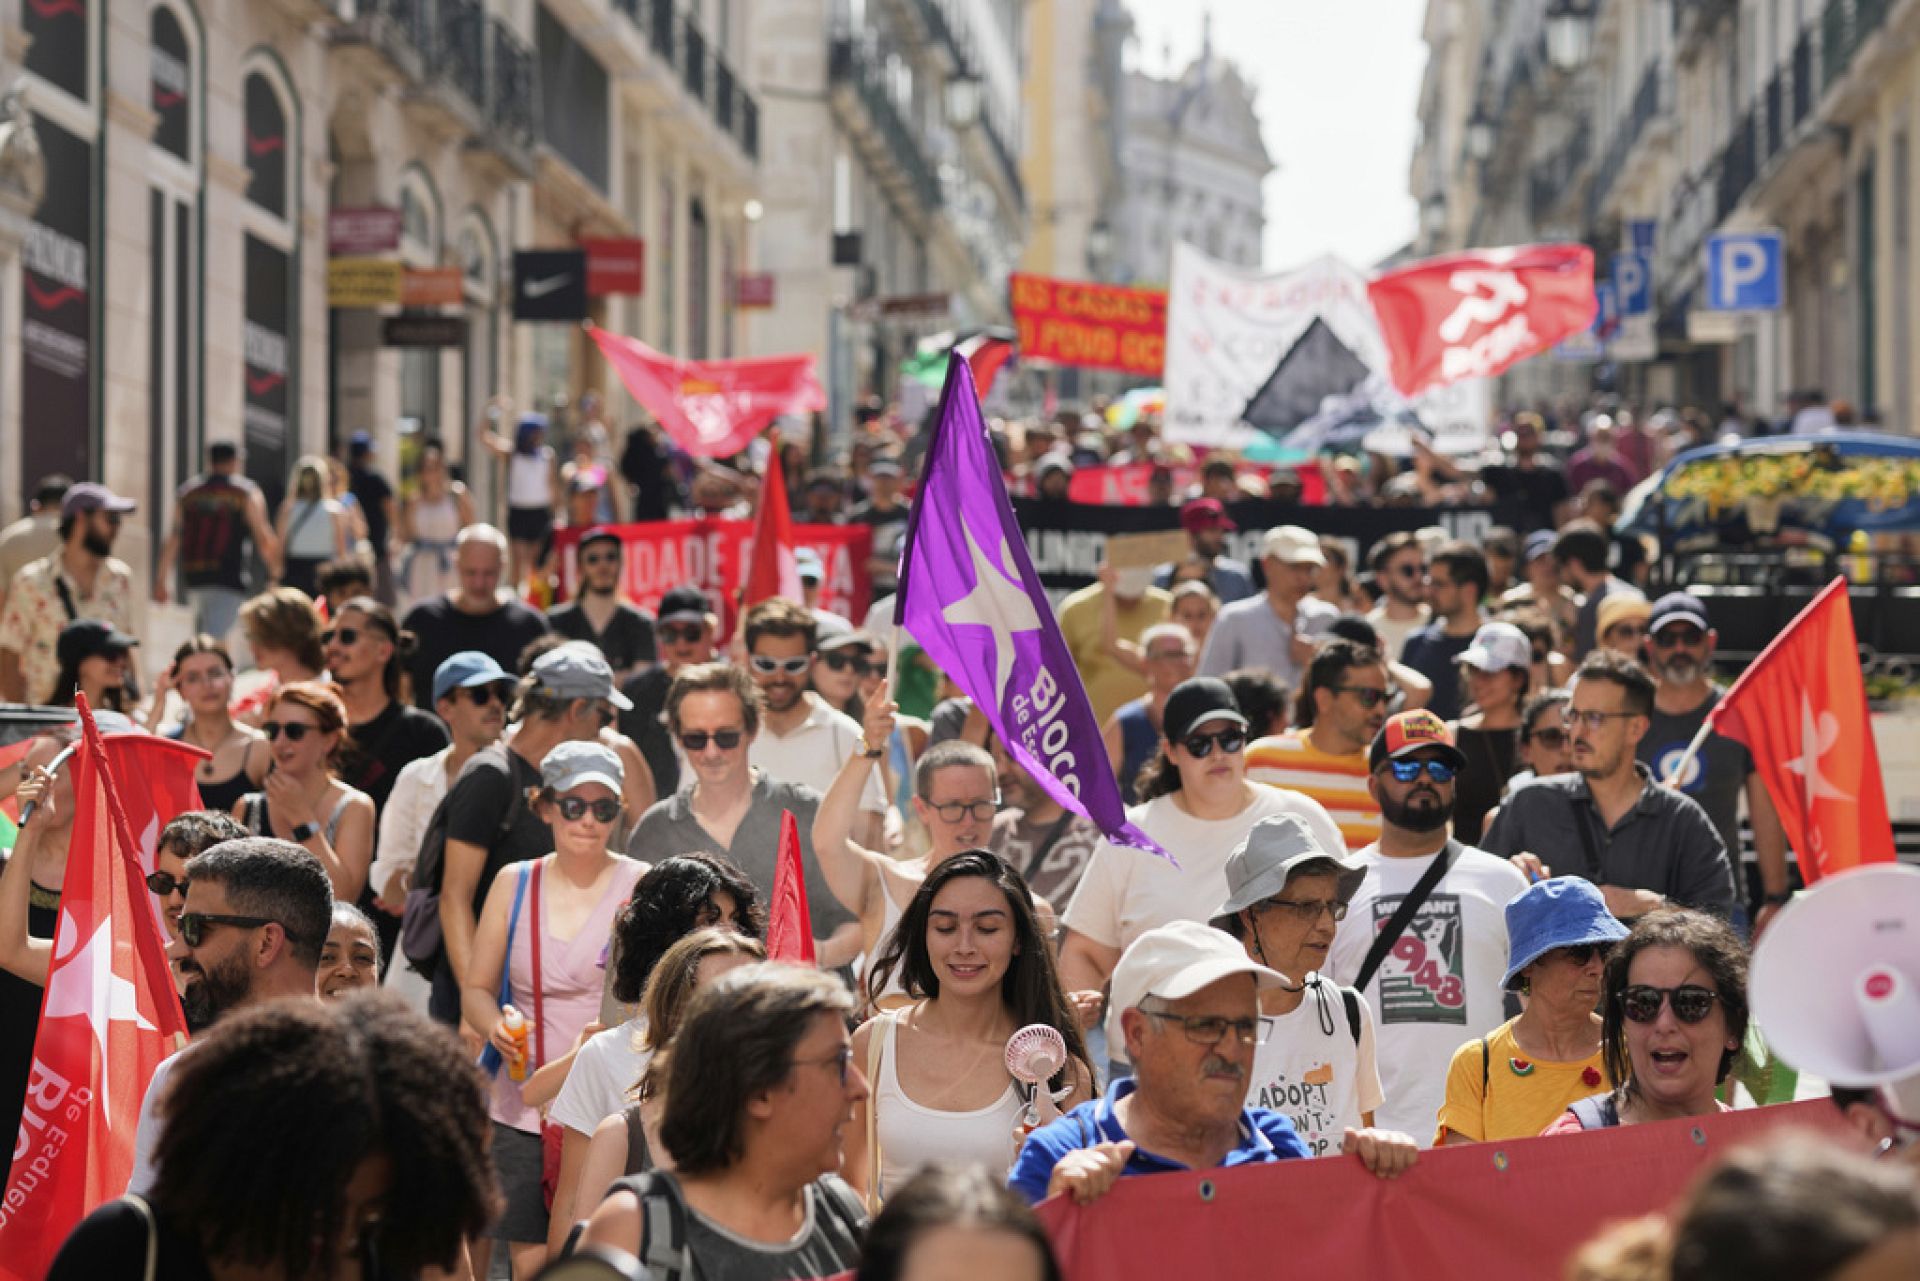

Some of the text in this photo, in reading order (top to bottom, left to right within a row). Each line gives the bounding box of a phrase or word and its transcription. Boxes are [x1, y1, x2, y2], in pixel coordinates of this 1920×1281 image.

[1722, 241, 1766, 306] P
[1012, 694, 1031, 725] de
[1259, 1081, 1329, 1110] ADOPT
